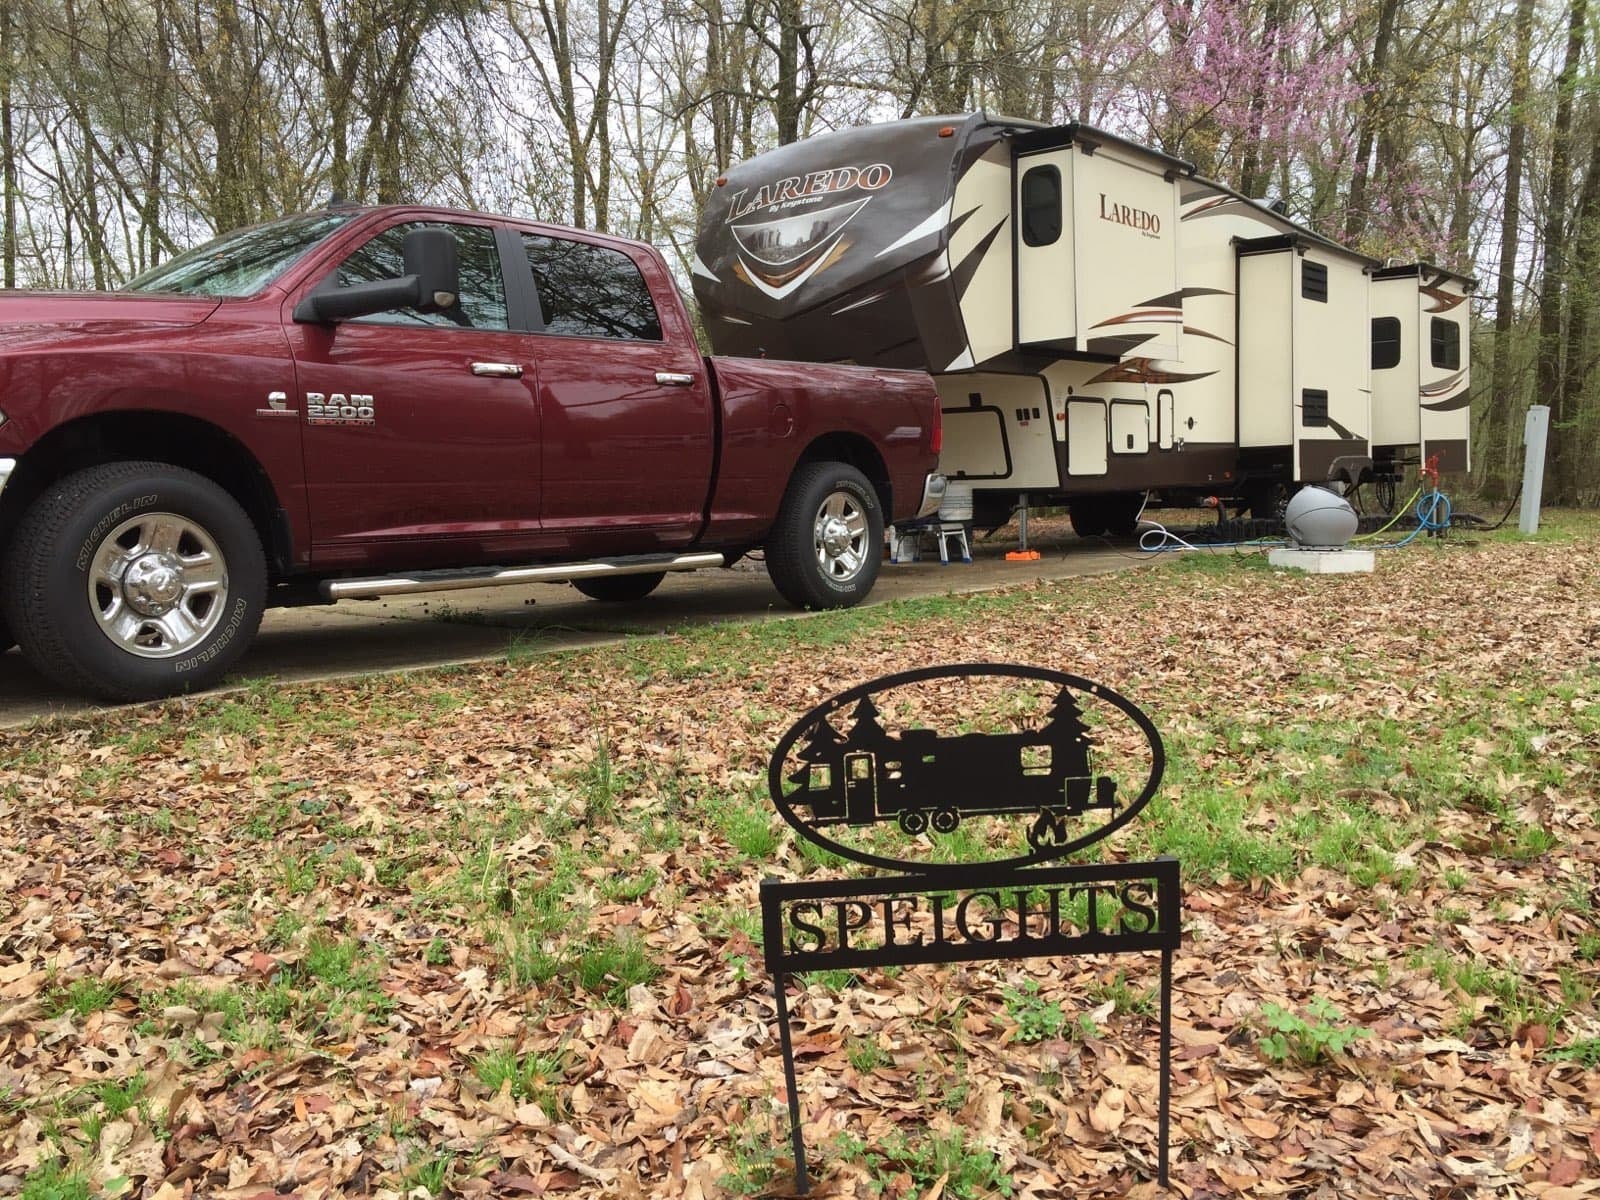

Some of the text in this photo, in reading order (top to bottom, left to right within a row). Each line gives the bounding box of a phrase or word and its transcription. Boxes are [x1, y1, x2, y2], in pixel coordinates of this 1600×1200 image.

[725, 163, 893, 225] LAREDO
[1099, 192, 1161, 234] LAREDO
[306, 392, 374, 407] RAM
[307, 405, 375, 418] 2500
[76, 494, 158, 572] MICHELIN
[175, 597, 247, 673] MICHELIN
[788, 882, 1157, 955] SPEIGHTS
